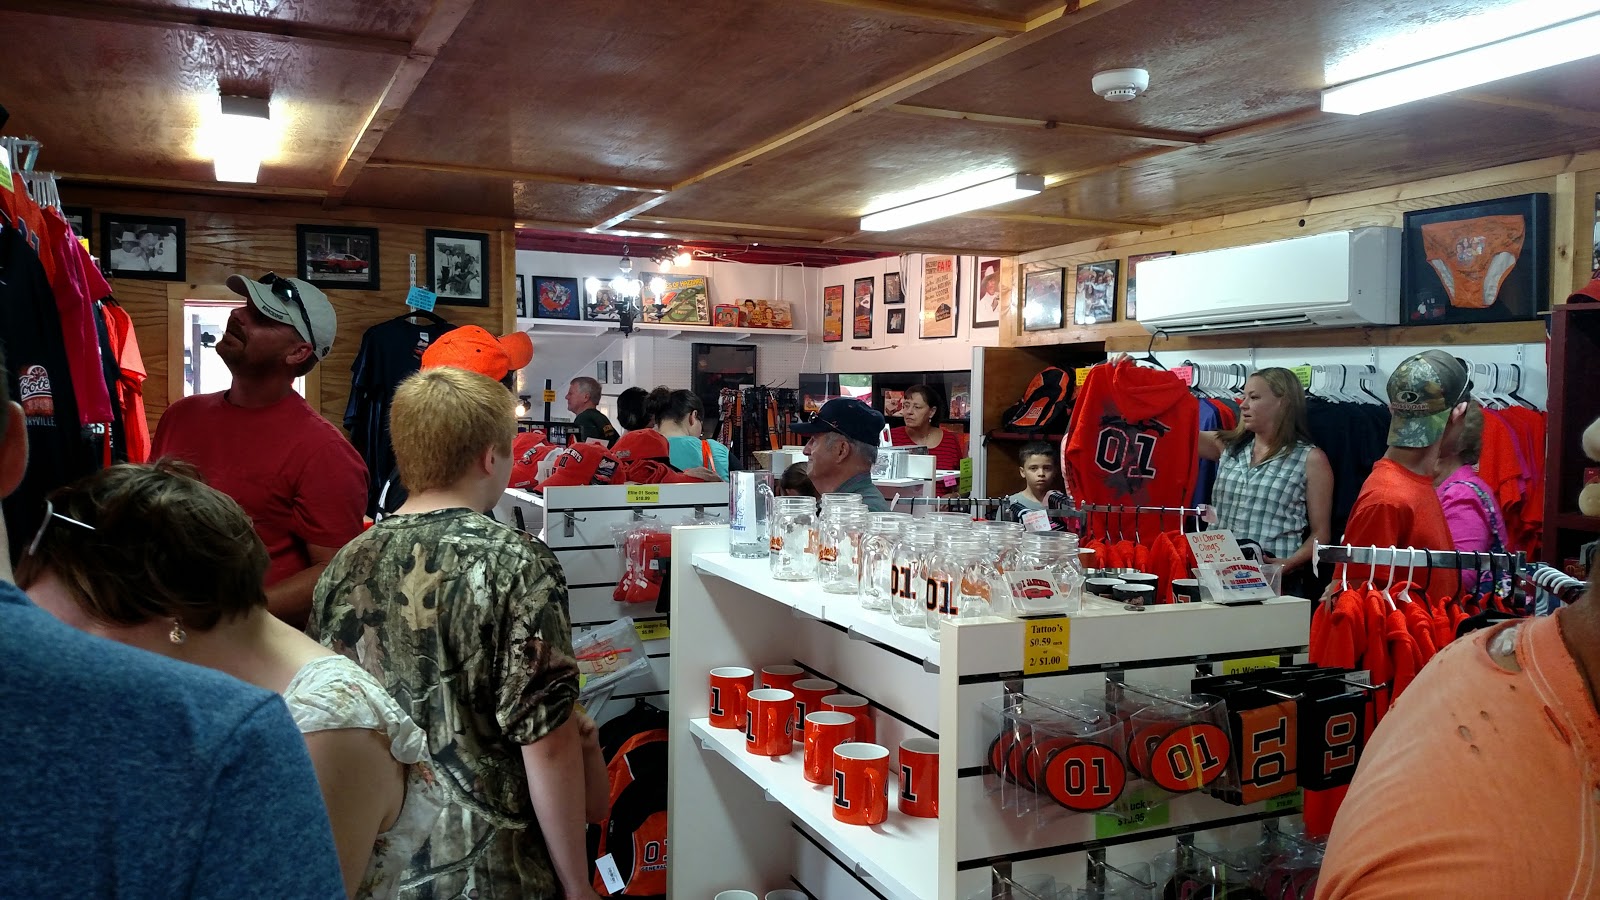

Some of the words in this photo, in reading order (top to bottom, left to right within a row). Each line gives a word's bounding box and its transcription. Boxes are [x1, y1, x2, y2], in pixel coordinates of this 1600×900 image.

[937, 260, 951, 272] FAIR
[1095, 426, 1158, 479] 01
[1198, 542, 1221, 554] Clings
[1202, 533, 1226, 543] Change
[891, 563, 917, 600] 01
[927, 577, 959, 616] 01
[1030, 637, 1051, 647] $0.59
[1031, 624, 1063, 634] Tattoo's
[1039, 656, 1061, 666] $1.00
[1166, 733, 1220, 781] 01
[1252, 716, 1288, 789] 01
[1324, 711, 1357, 776] 01
[1064, 757, 1111, 796] 01
